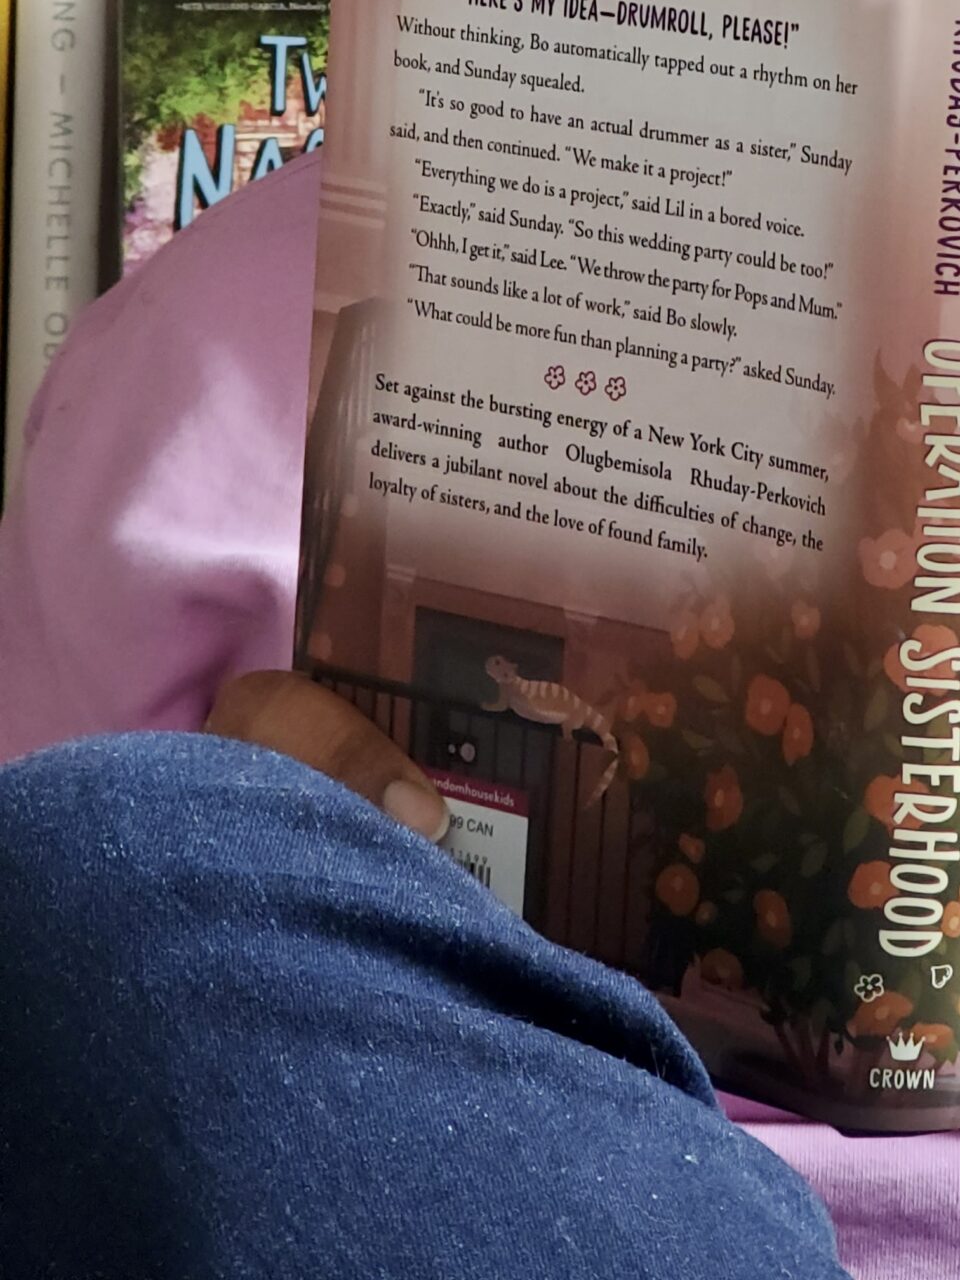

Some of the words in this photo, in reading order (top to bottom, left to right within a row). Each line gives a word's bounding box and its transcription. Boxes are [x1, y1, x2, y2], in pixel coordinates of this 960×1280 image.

[722, 14, 799, 49] PLEASE!”
[393, 50, 431, 73] book,
[435, 58, 459, 76] and
[464, 61, 516, 87] Sunday
[520, 67, 585, 94] squealed.
[44, 111, 72, 290] MICHELLE
[467, 819, 494, 837] CAN
[869, 1067, 935, 1090] CROWN
